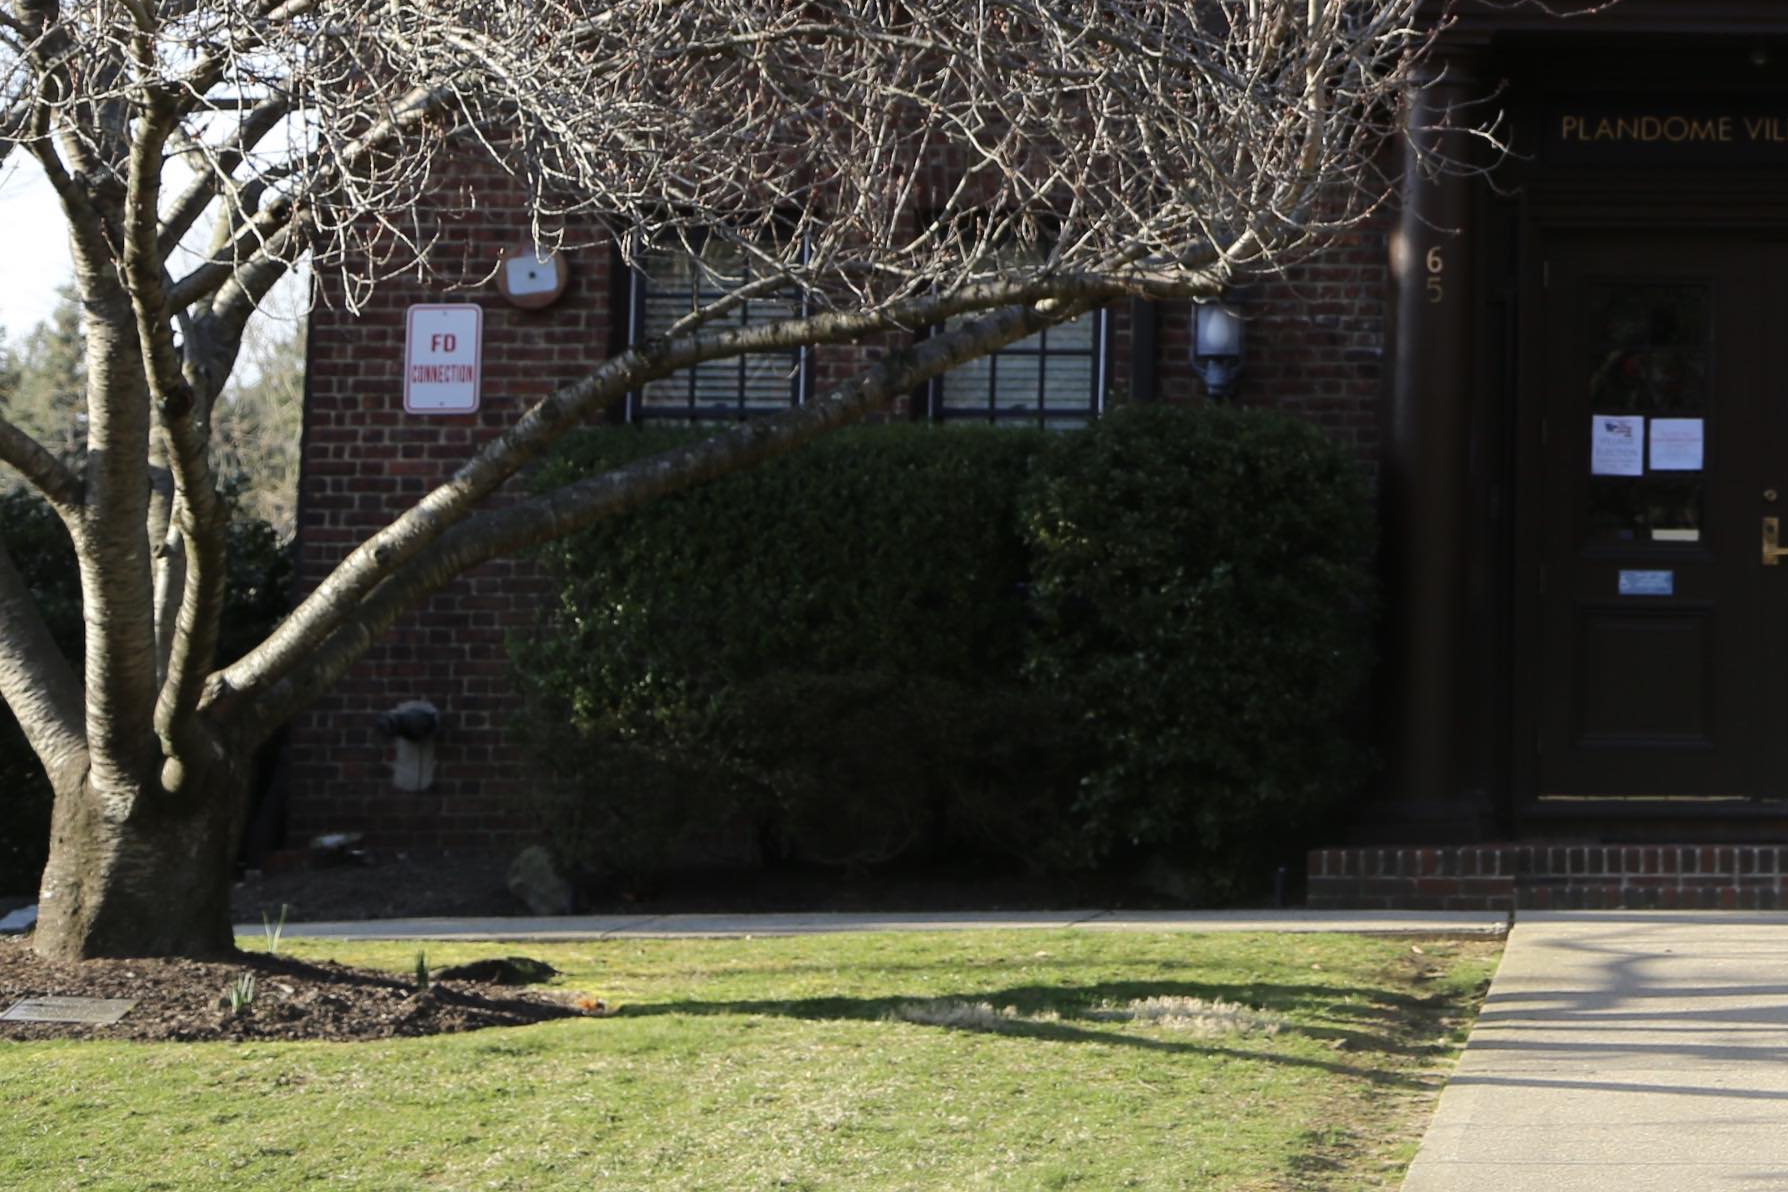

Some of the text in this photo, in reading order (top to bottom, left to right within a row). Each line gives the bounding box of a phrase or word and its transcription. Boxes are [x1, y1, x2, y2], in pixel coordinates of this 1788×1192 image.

[1562, 116, 1733, 141] PLANDOME
[431, 333, 457, 353] FD
[411, 364, 474, 384] CONNECTION
